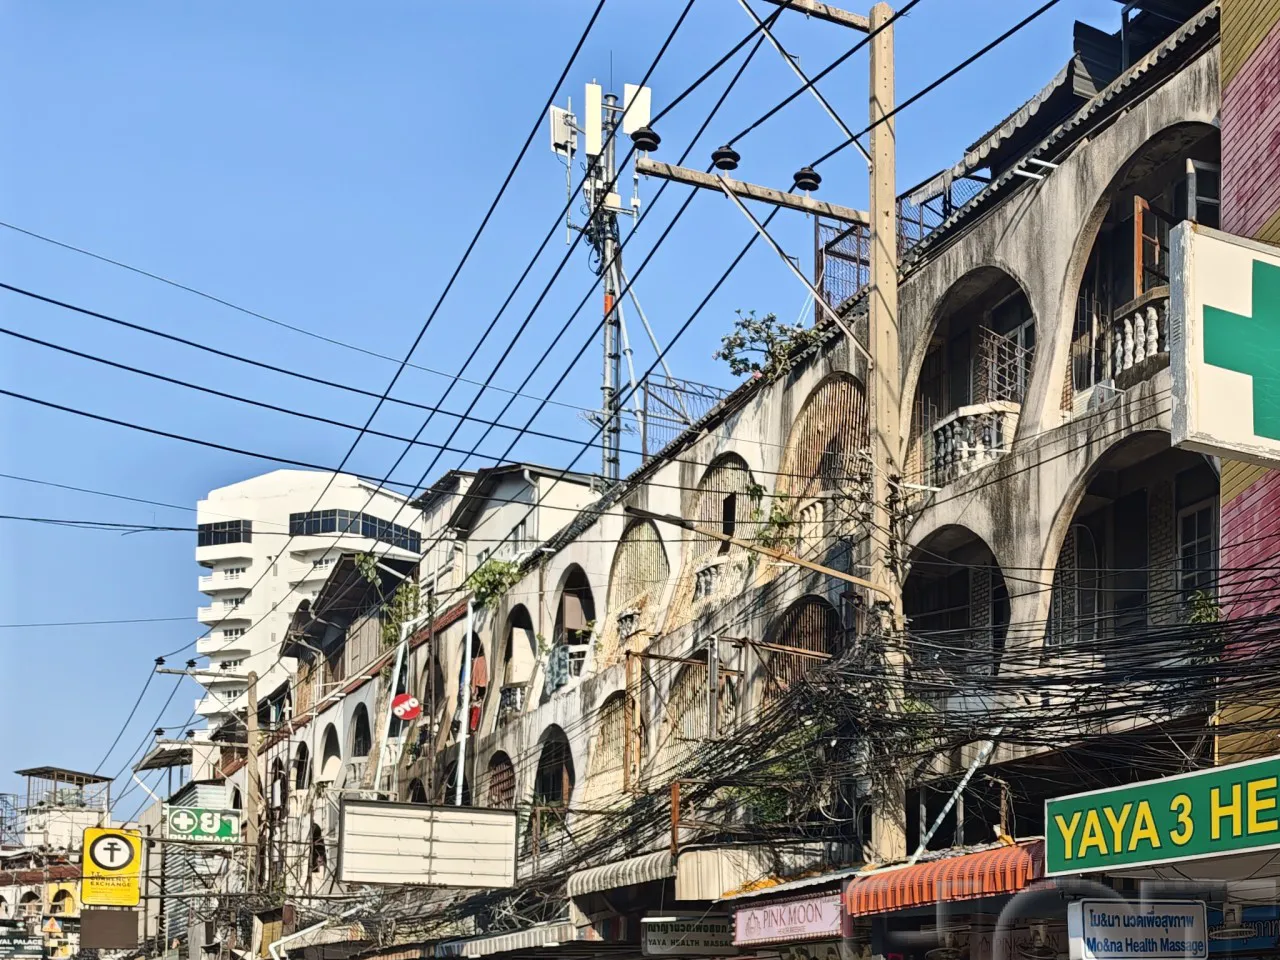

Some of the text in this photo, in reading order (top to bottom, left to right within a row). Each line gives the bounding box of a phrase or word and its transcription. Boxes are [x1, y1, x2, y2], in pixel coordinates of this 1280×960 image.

[200, 812, 238, 835] ยา
[1056, 792, 1160, 859] YAYA
[1170, 794, 1194, 845] 3
[763, 903, 823, 929] PINK MOON
[1089, 909, 1120, 928] โม&นา
[1123, 905, 1194, 934] นวดเพื่อสุขภาพ
[670, 939, 700, 947] HEALTH
[1086, 937, 1204, 955] Mo&na Health Massage
